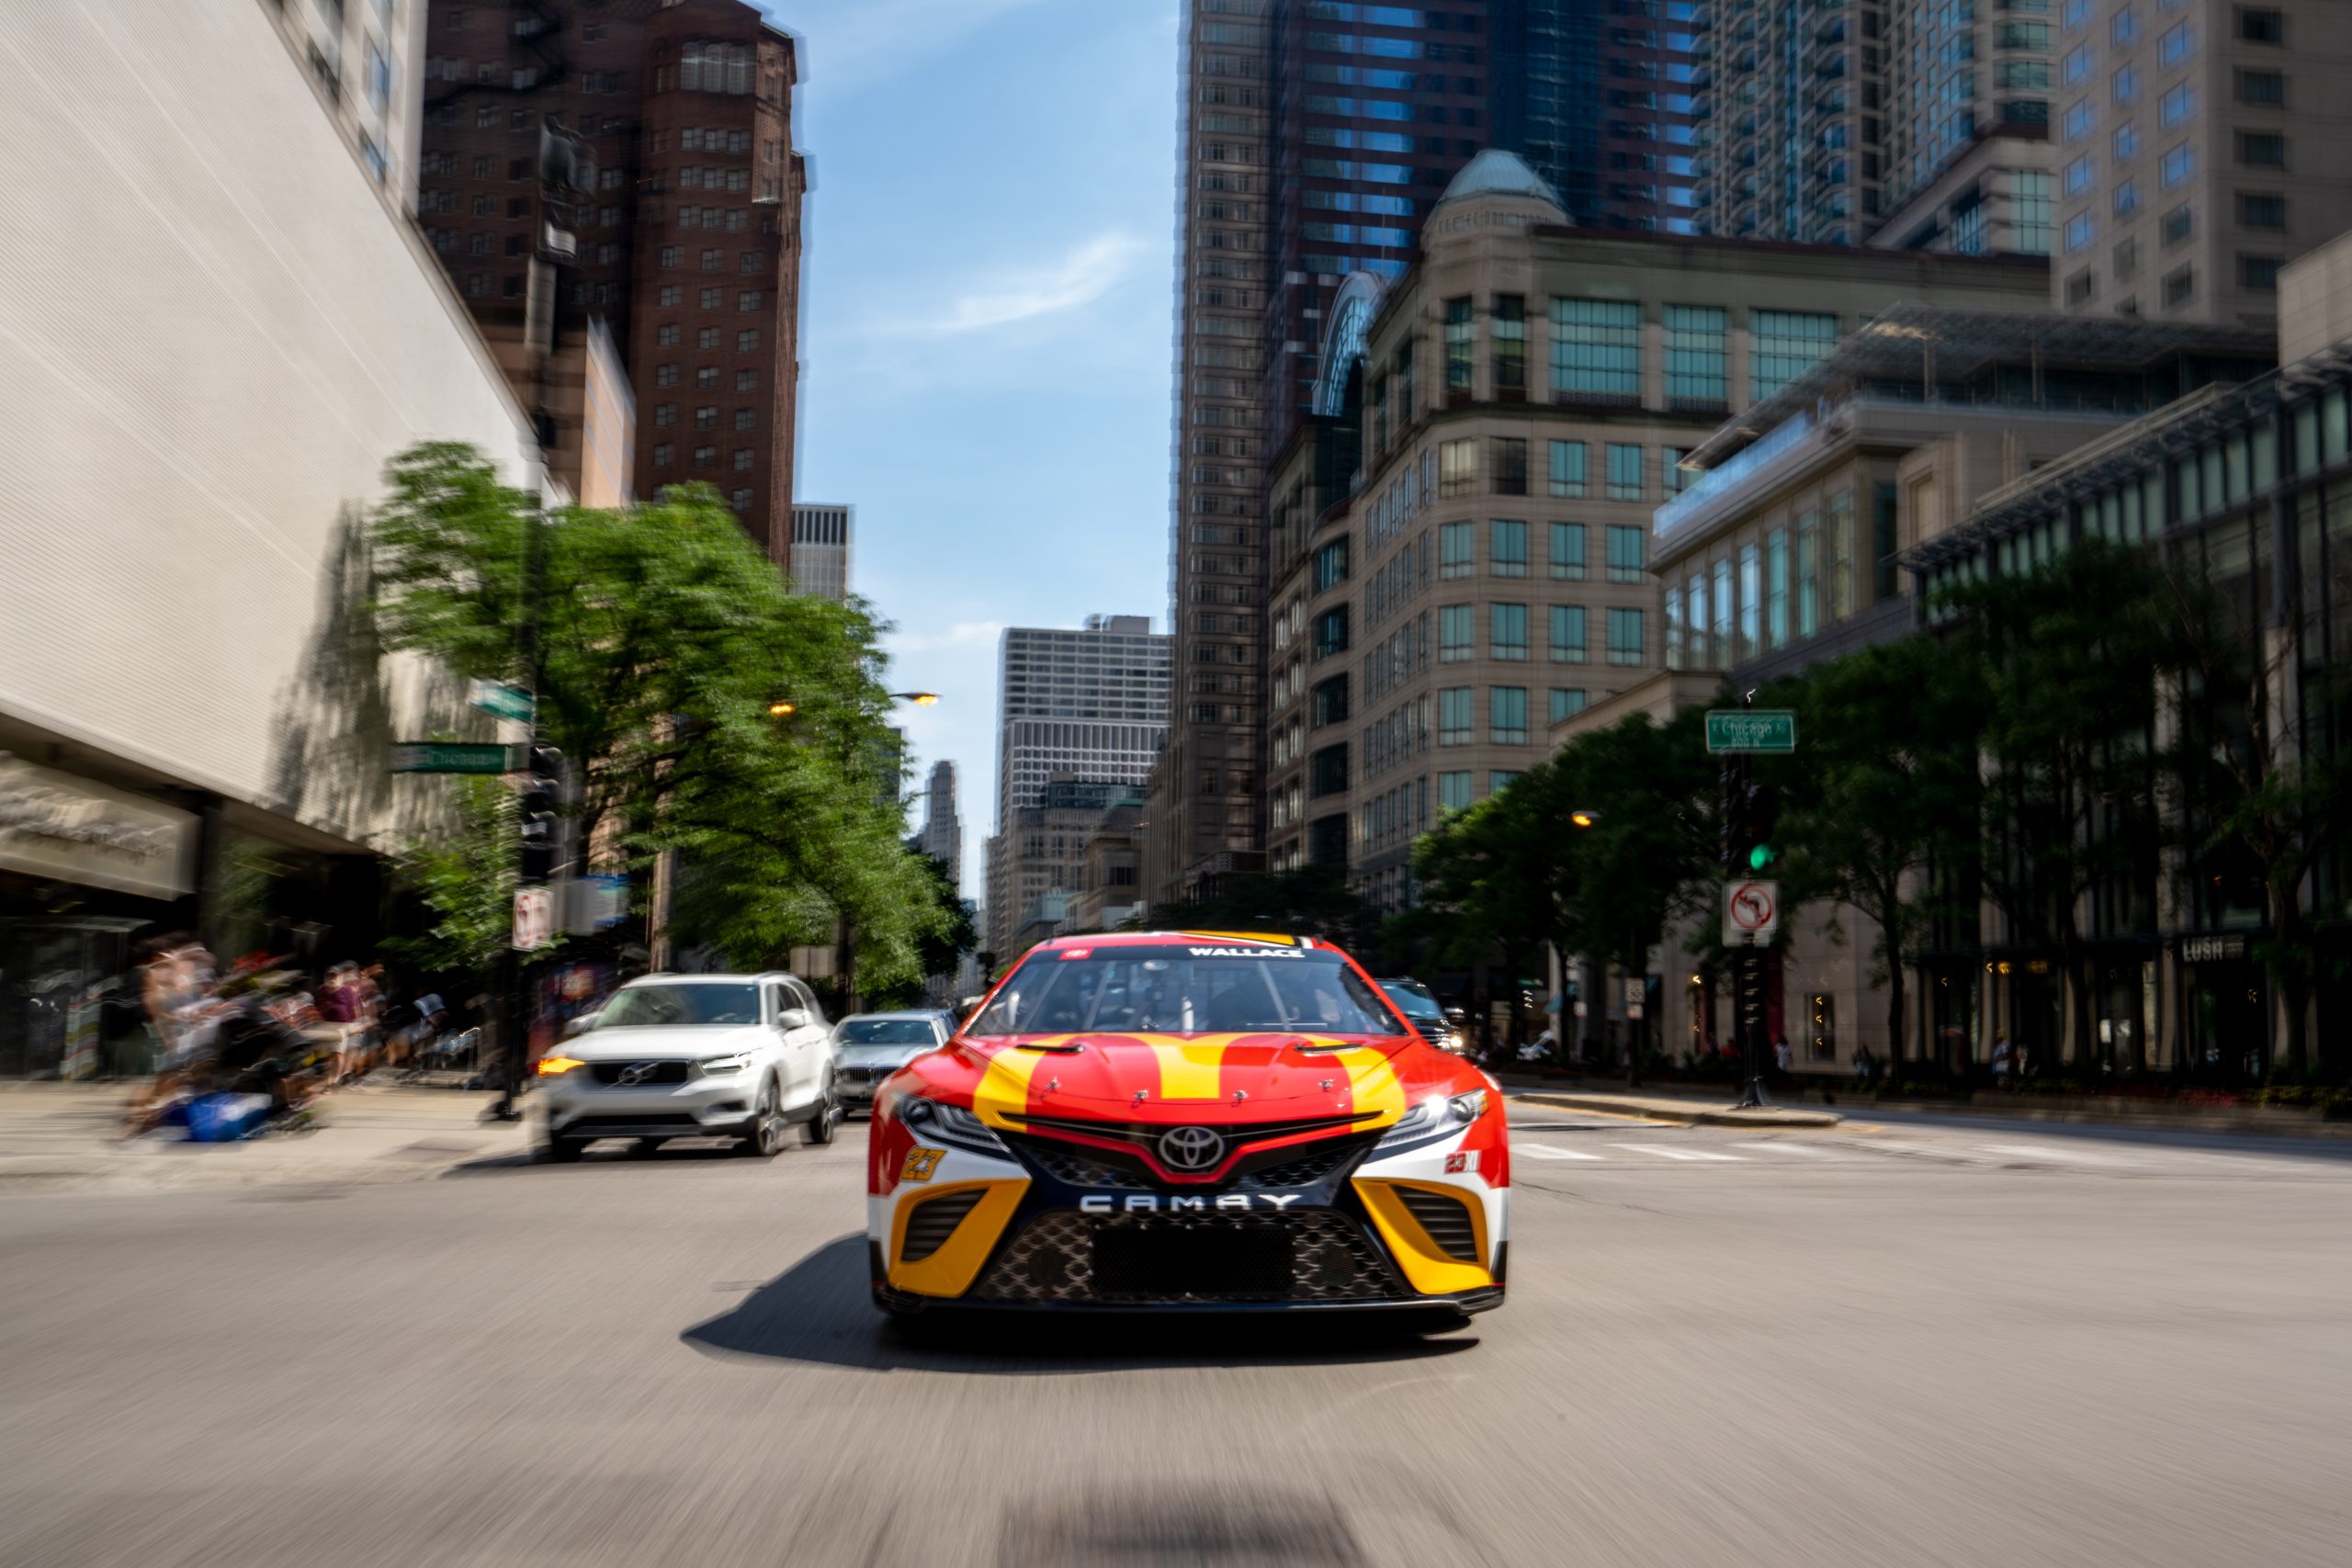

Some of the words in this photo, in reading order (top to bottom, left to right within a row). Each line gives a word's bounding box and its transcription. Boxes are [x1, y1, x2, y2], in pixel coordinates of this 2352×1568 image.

[1723, 718, 1772, 739] Chicago
[1189, 948, 1305, 957] WALLACE
[2182, 938, 2223, 962] LUSH
[1080, 1194, 1302, 1213] CAMRY
